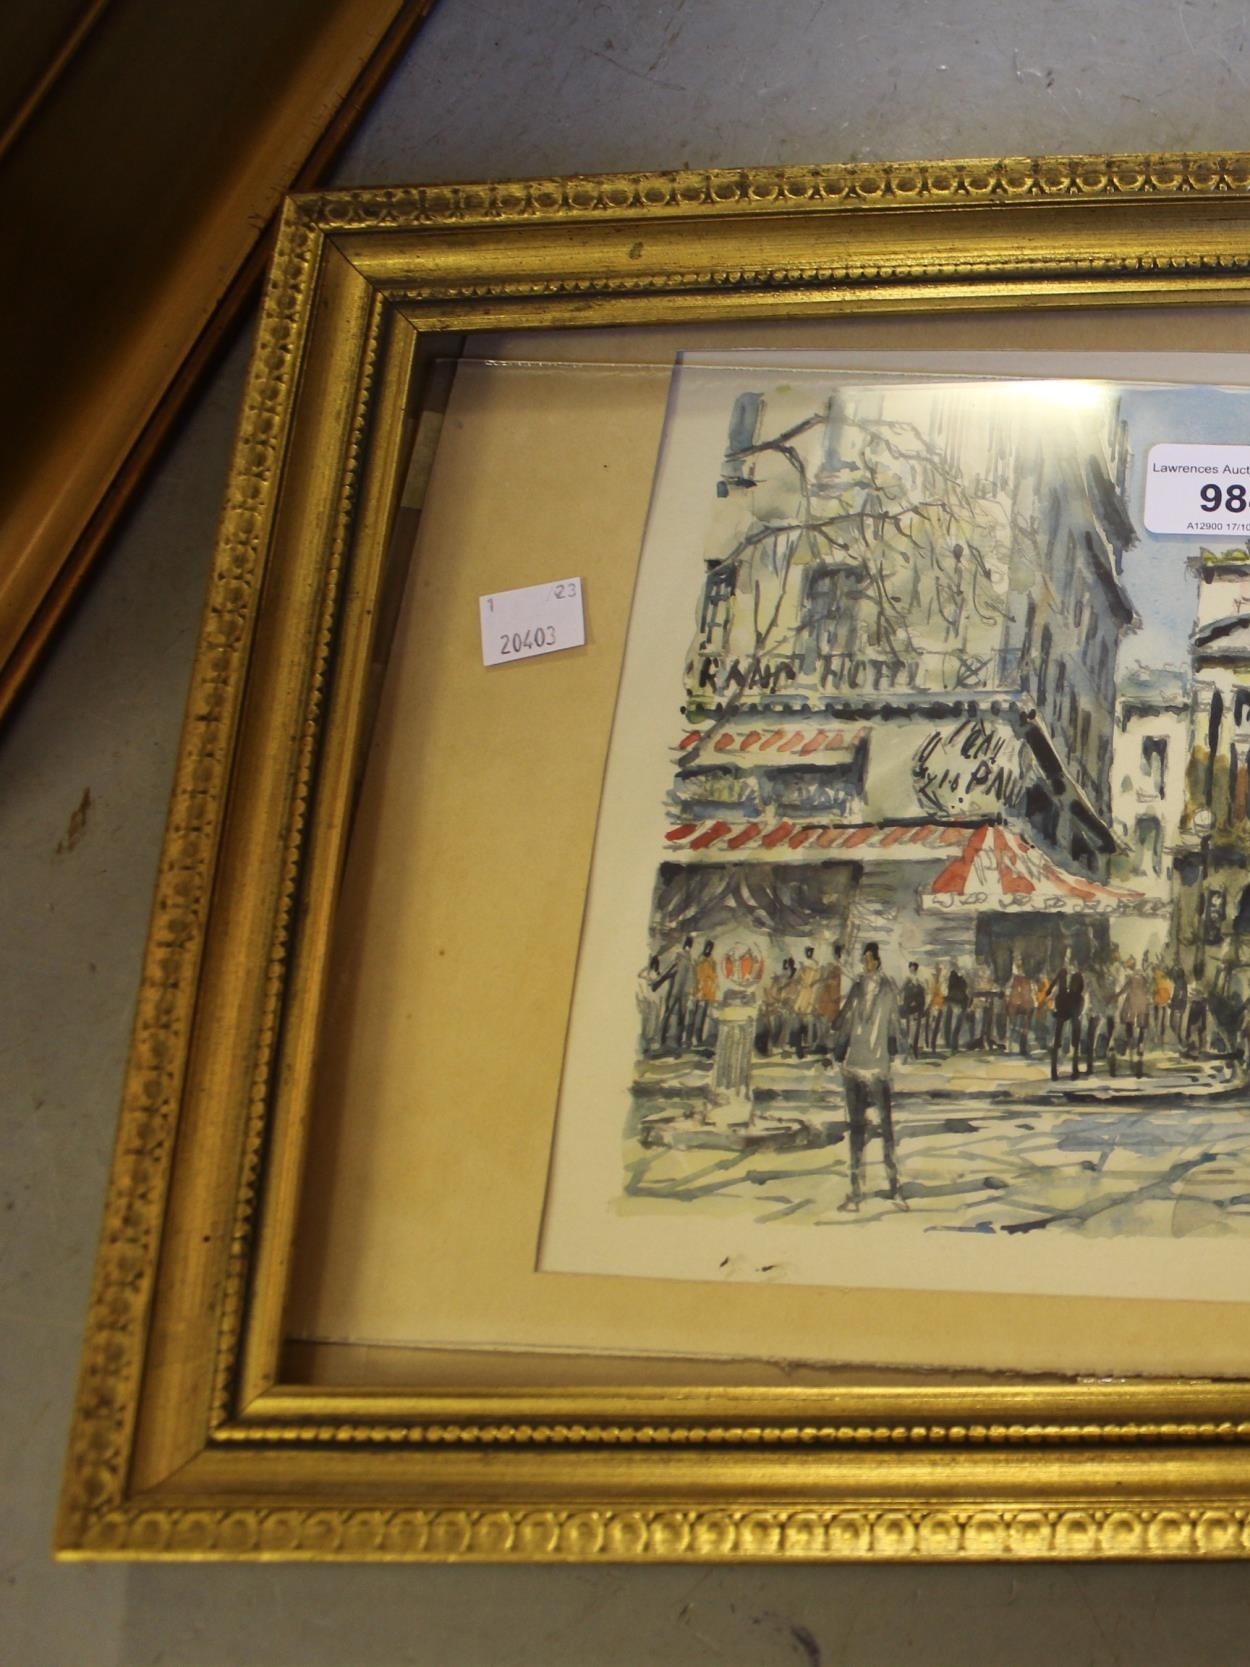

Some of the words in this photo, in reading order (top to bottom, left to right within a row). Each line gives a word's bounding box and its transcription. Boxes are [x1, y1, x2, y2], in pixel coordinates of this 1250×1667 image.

[1152, 462, 1219, 474] Lawrences
[1186, 521, 1223, 531] A12900
[499, 625, 558, 655] 20403
